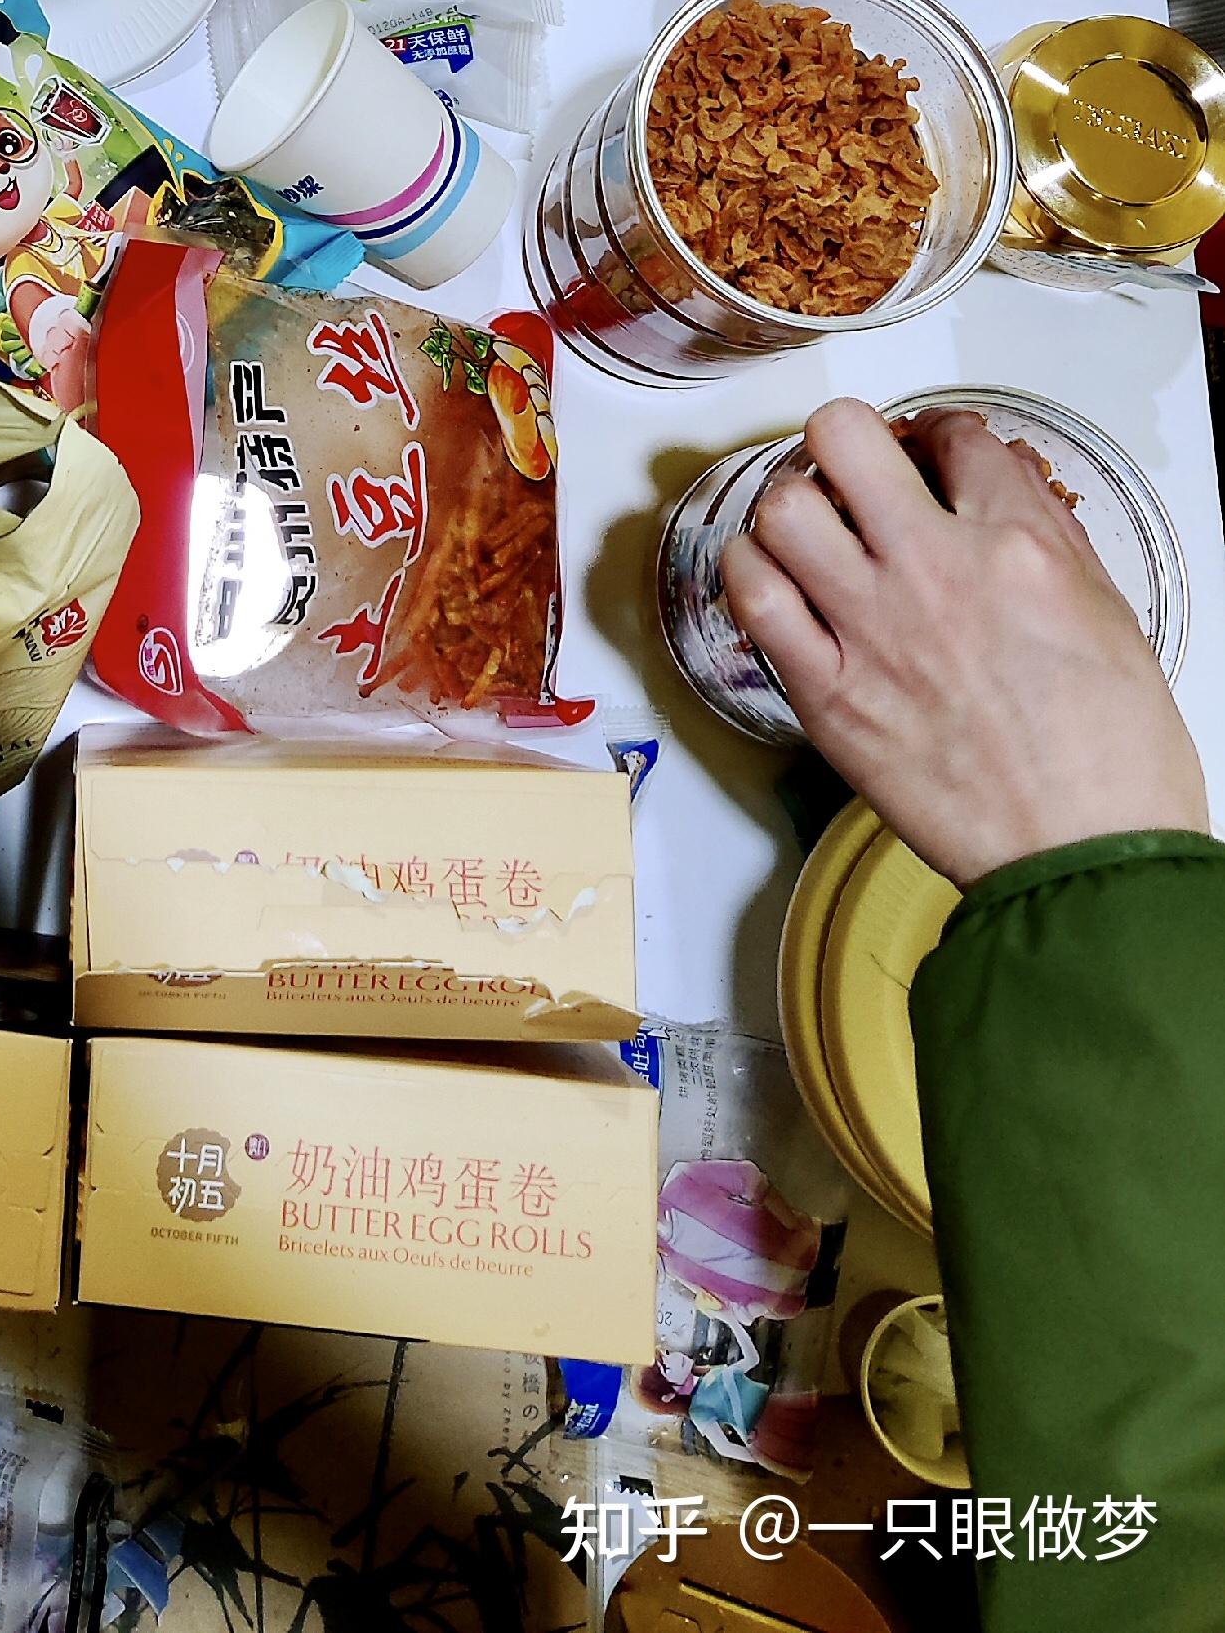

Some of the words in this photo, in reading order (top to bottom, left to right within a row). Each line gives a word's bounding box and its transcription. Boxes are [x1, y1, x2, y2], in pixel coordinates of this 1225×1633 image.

[367, 7, 434, 35] 0120A-14B
[383, 28, 468, 54] 21天保鲜
[303, 307, 428, 685] 土豆丝
[267, 971, 391, 993] BUTTER
[398, 974, 472, 995] EGG
[266, 989, 340, 1004] Bricelets
[345, 994, 375, 1005] aux
[379, 991, 433, 1006] Oeufs
[462, 995, 521, 1009] beurre
[168, 1144, 225, 1173] 十月
[286, 1137, 559, 1220] 奶油鸡蛋卷
[168, 1175, 226, 1215] 初五
[150, 1225, 205, 1243] OCTOBER
[207, 1231, 240, 1246] FIFTH
[281, 1198, 407, 1240] BUTTER
[411, 1210, 480, 1249] EGG
[491, 1220, 593, 1262] ROLLS
[278, 1233, 355, 1260] Bricelets
[358, 1246, 390, 1264] aux
[393, 1243, 446, 1269] Oeufs
[448, 1251, 472, 1271] de
[475, 1254, 534, 1279] beurre
